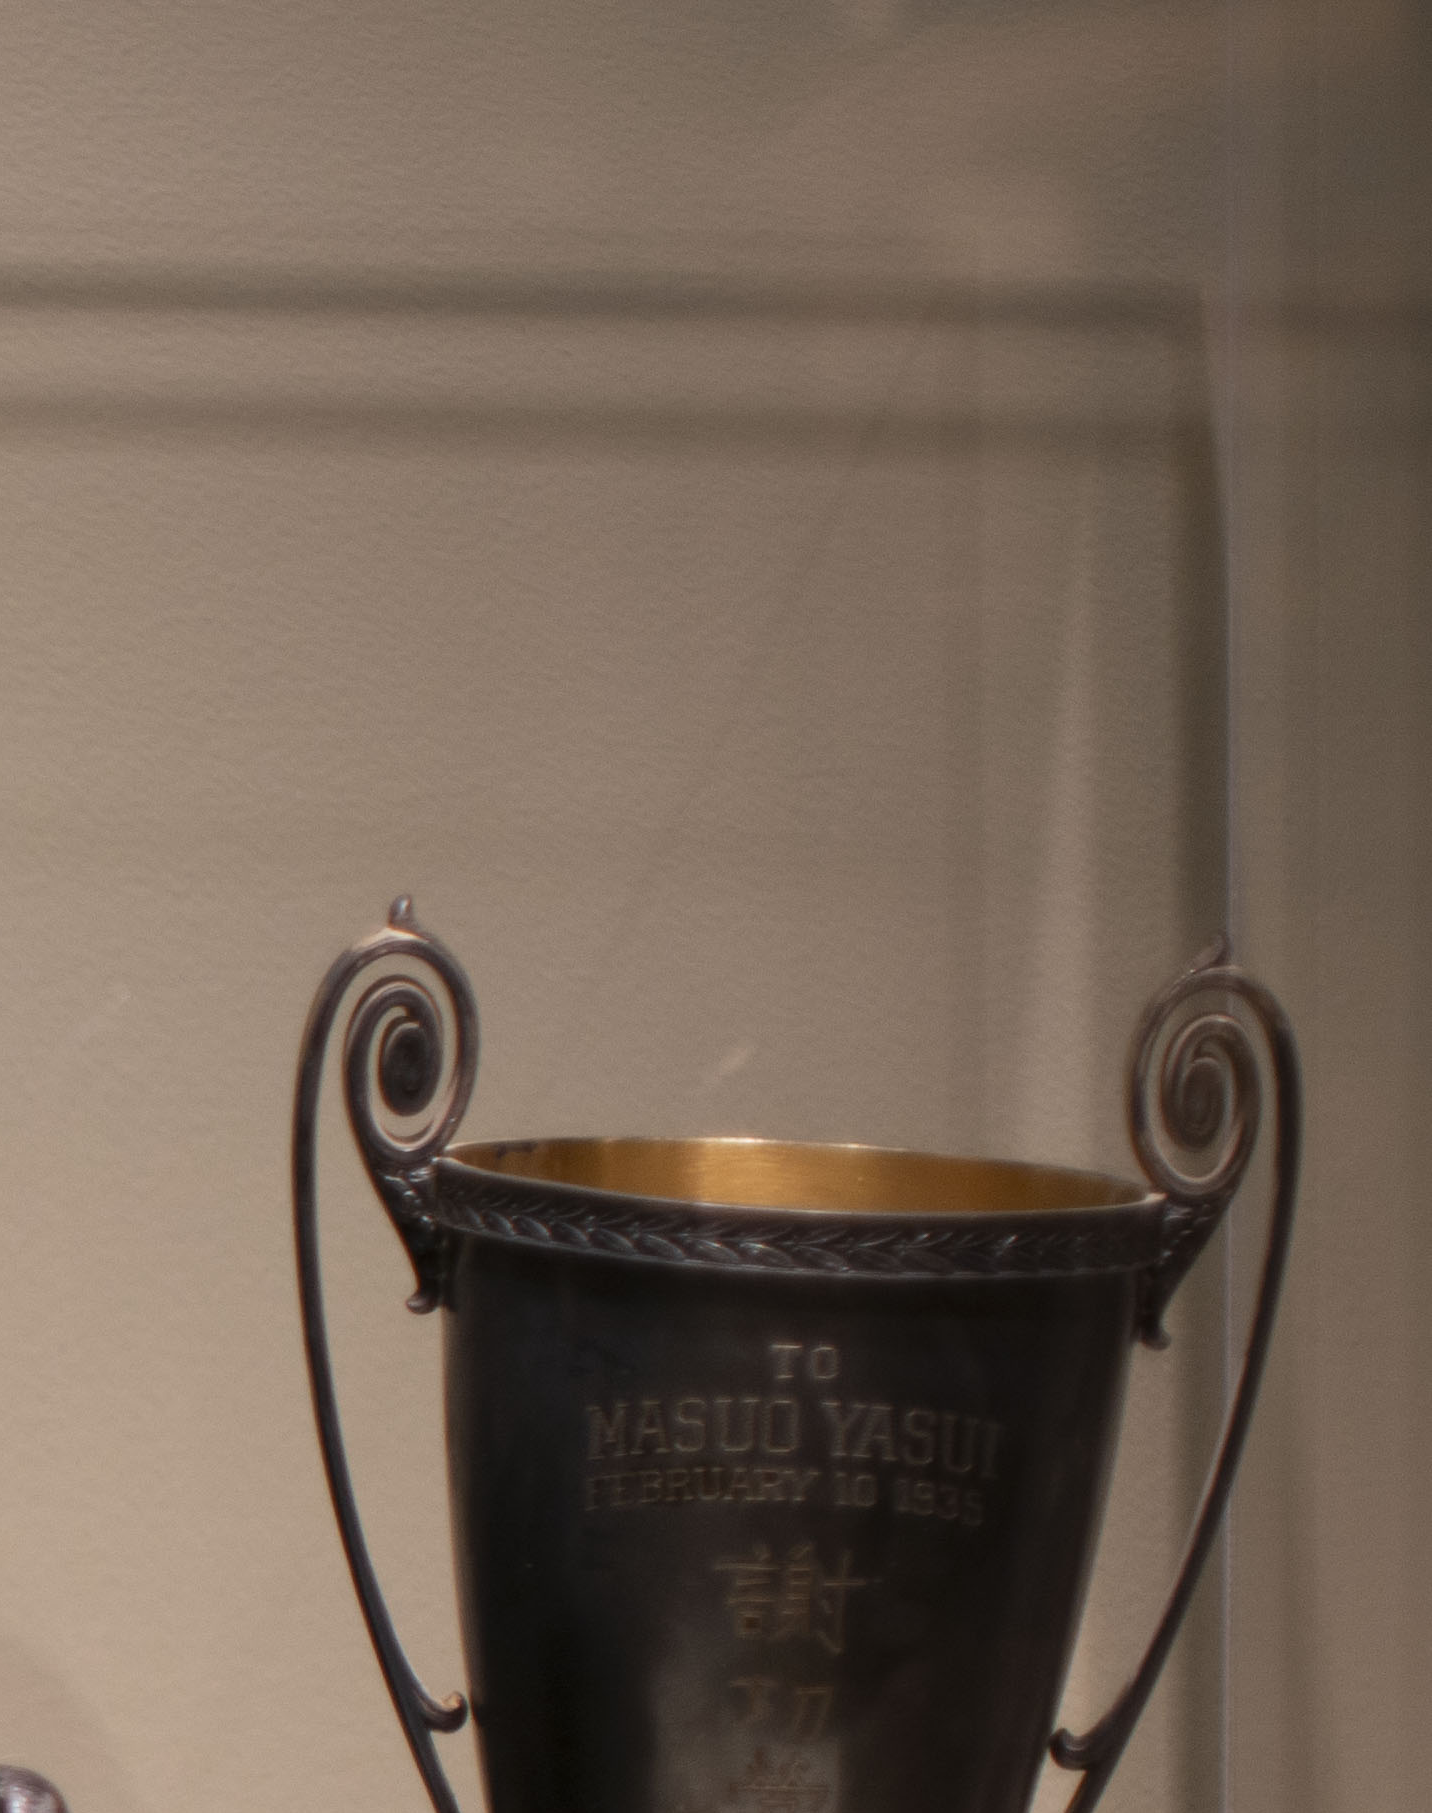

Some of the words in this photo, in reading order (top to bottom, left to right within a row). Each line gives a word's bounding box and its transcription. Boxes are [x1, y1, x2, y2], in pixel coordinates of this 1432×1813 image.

[770, 1342, 840, 1380] TO
[585, 1398, 802, 1461] MASUO
[822, 1401, 1003, 1480] YASUI
